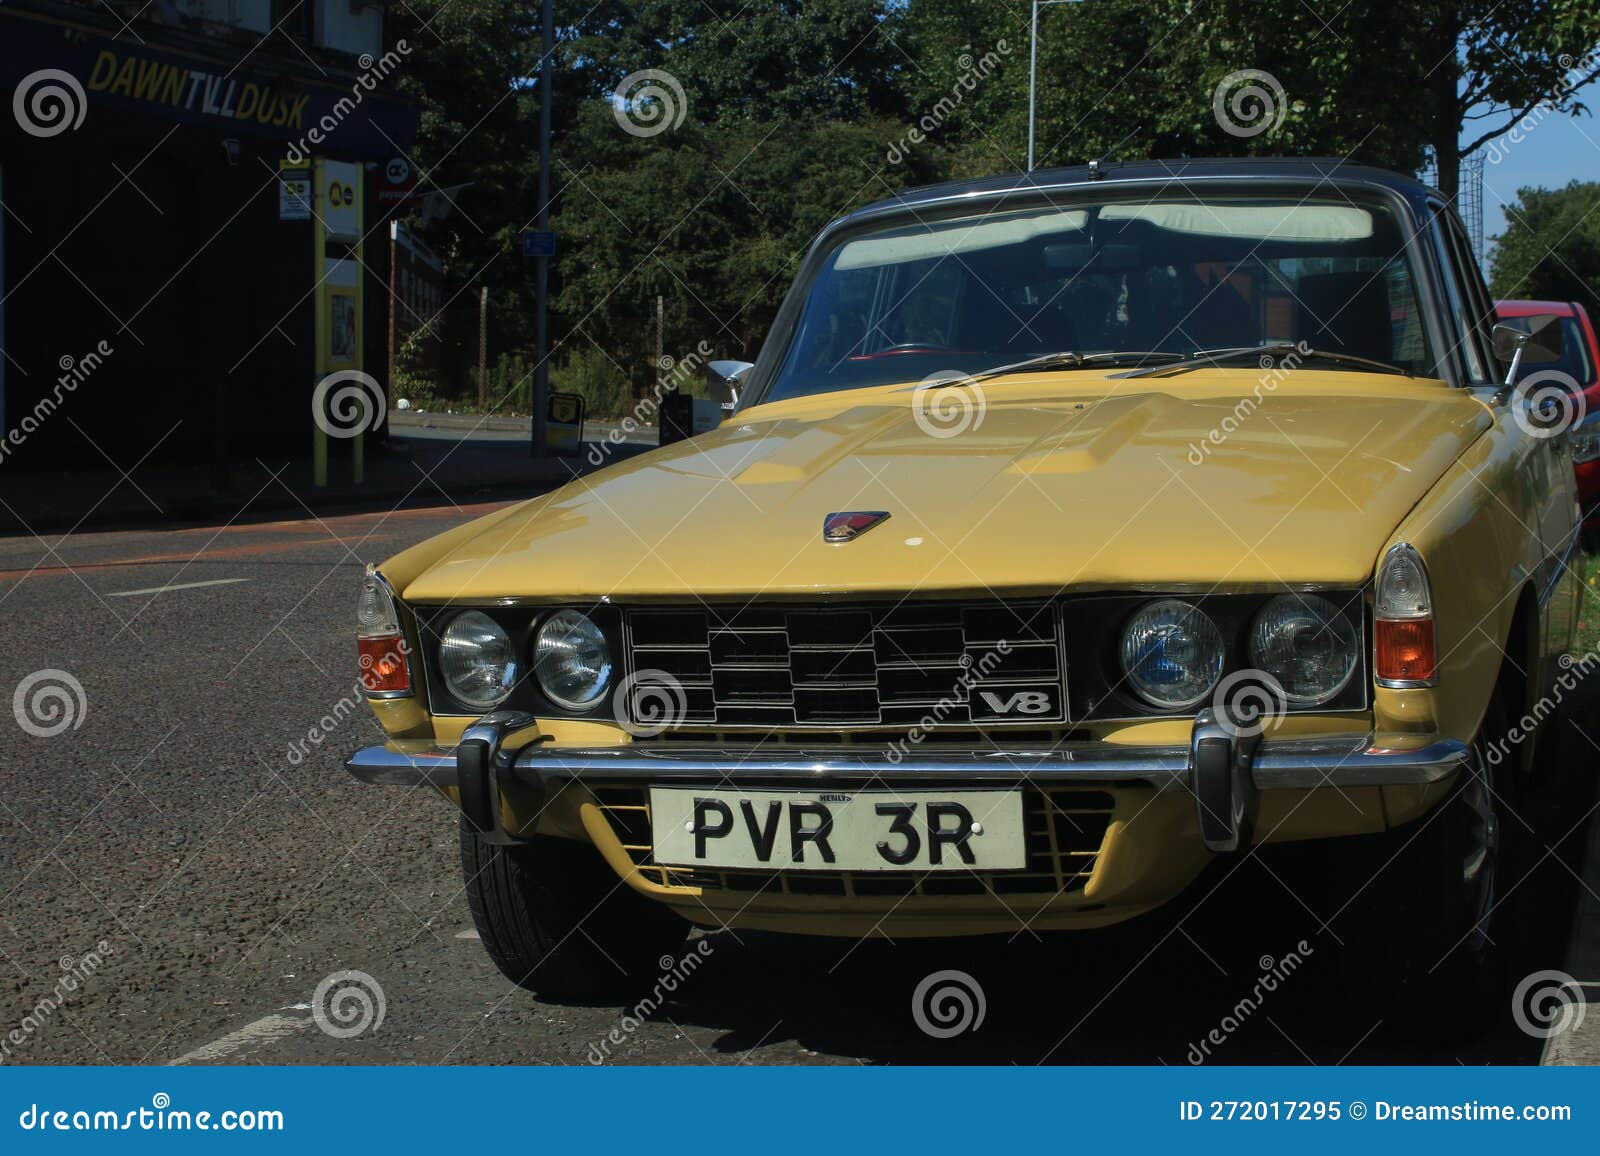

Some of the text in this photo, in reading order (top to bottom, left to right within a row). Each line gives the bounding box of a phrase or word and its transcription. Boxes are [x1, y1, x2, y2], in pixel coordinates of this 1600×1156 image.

[979, 691, 1052, 714] V8
[693, 797, 977, 865] PVR 3R
